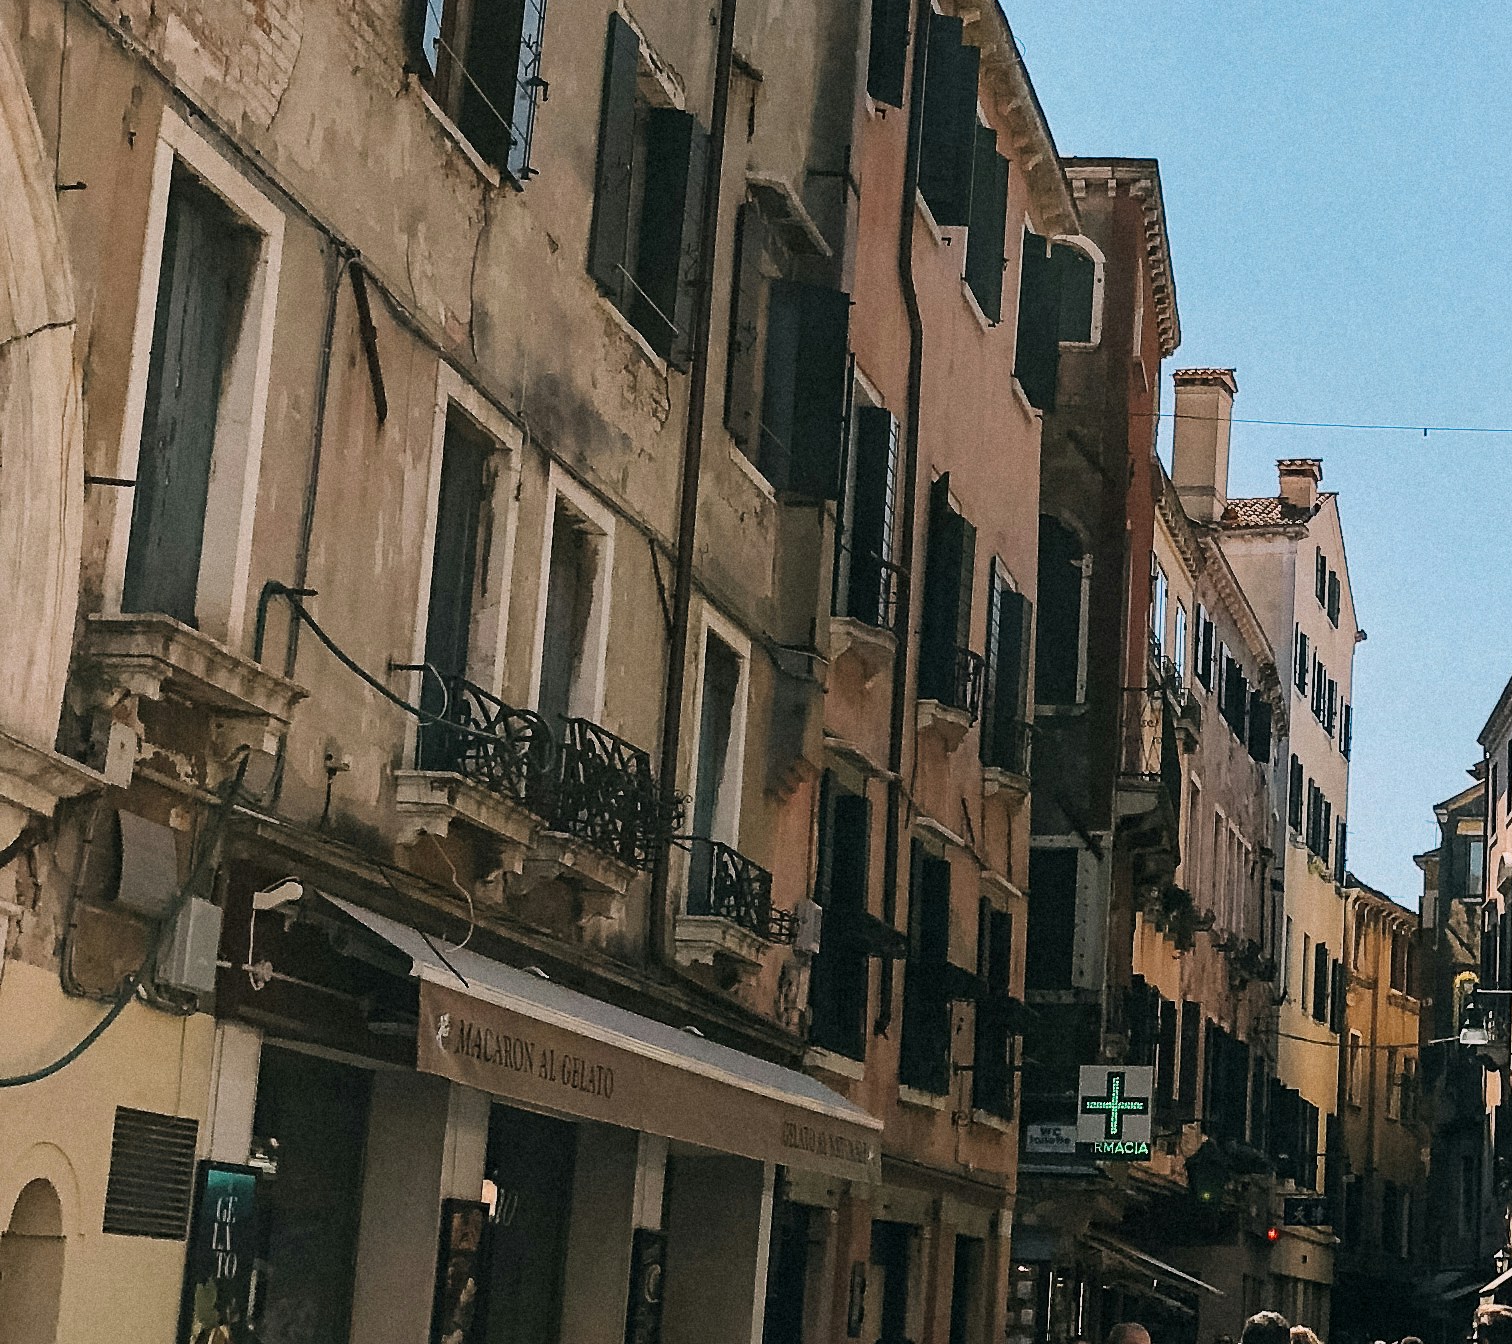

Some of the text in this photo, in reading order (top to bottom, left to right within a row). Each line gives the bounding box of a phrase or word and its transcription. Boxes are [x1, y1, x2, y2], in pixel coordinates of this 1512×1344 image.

[454, 1020, 614, 1099] MACARON AL GELATO
[1089, 1141, 1149, 1155] RMACIA
[216, 1195, 239, 1223] GE
[215, 1250, 238, 1279] TO
